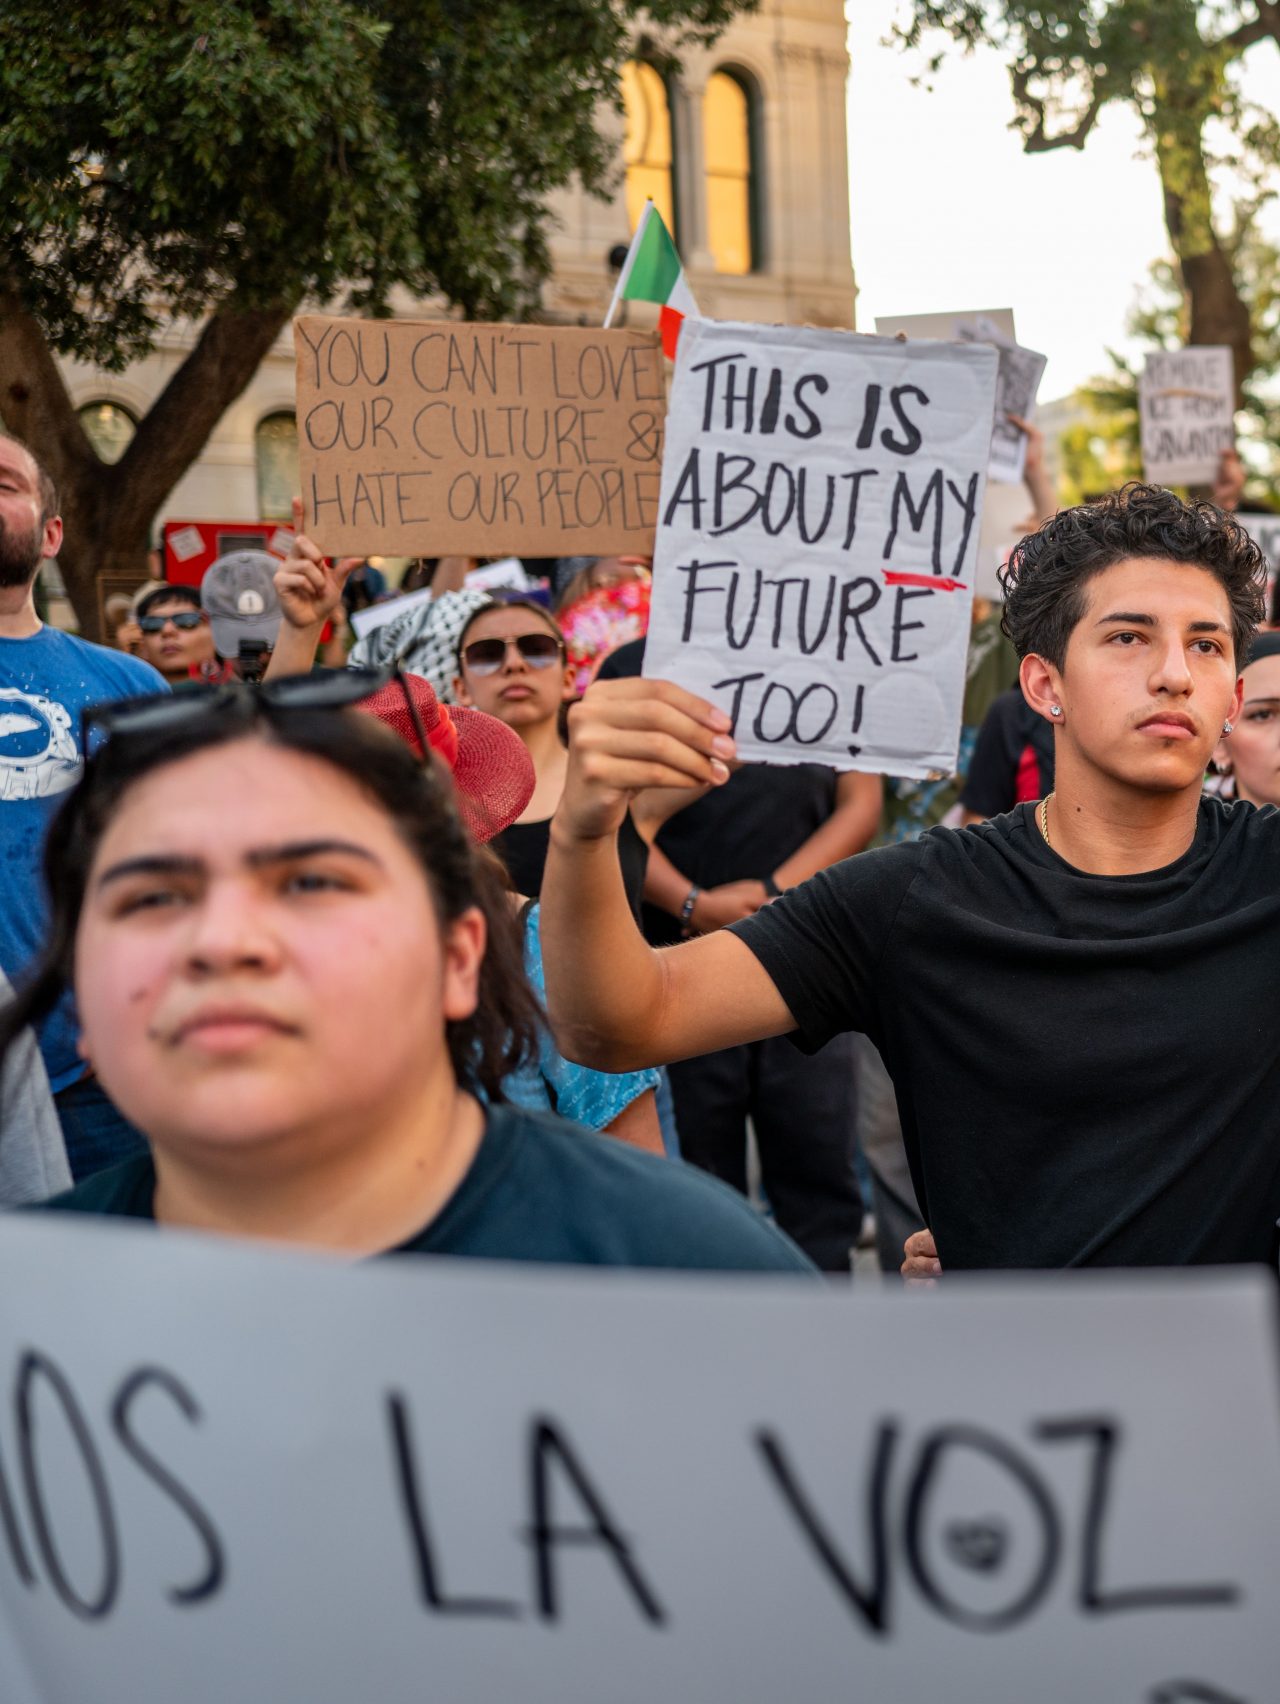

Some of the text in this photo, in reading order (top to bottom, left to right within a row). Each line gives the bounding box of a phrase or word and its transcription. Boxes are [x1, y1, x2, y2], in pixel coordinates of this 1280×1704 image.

[297, 322, 667, 402] YOU CAN'T LOVE
[691, 353, 829, 442] THIS
[856, 384, 931, 456] IS
[305, 396, 664, 467] OUR CULTURE &
[312, 468, 662, 531] HATE OUR PEOPLE
[663, 447, 980, 577] ABOUT MY
[677, 559, 935, 667] FUTURE
[711, 671, 867, 757] TOO!
[386, 1386, 670, 1630] LA
[752, 1412, 1242, 1638] VOZ
